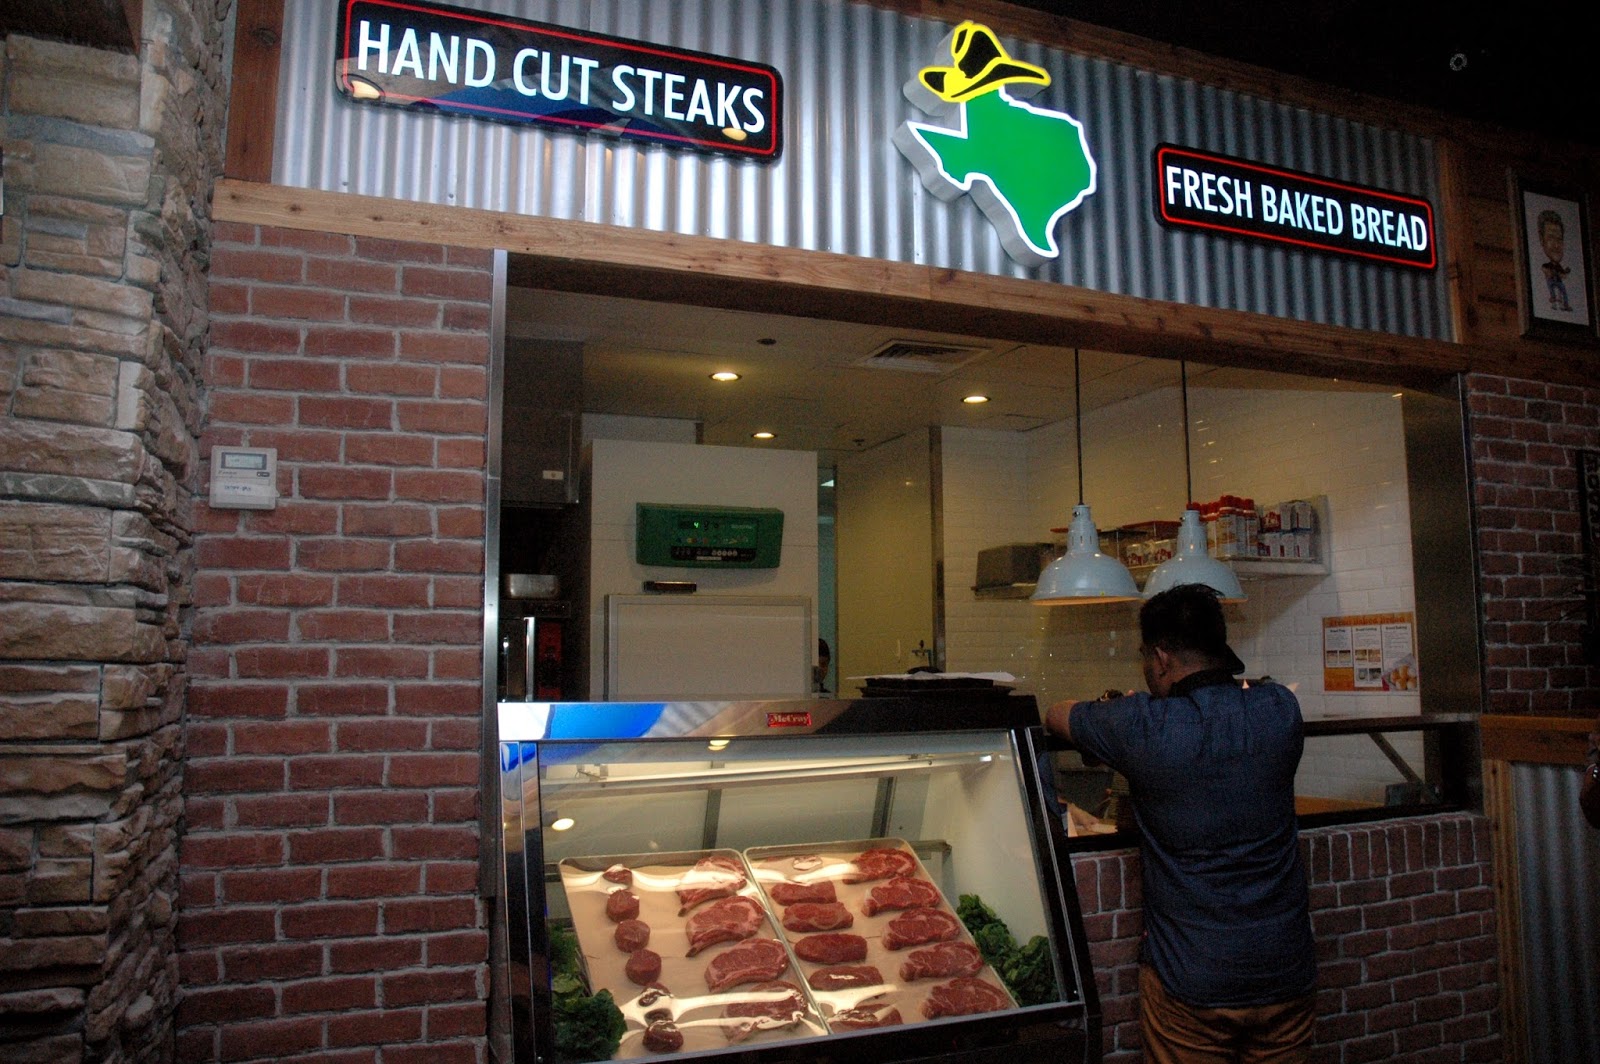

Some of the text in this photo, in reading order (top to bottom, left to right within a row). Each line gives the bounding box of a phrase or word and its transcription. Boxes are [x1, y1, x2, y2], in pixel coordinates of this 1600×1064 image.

[357, 20, 766, 134] HAND CUT STEAKS
[1165, 165, 1428, 252] FRESH BAKED BREAD
